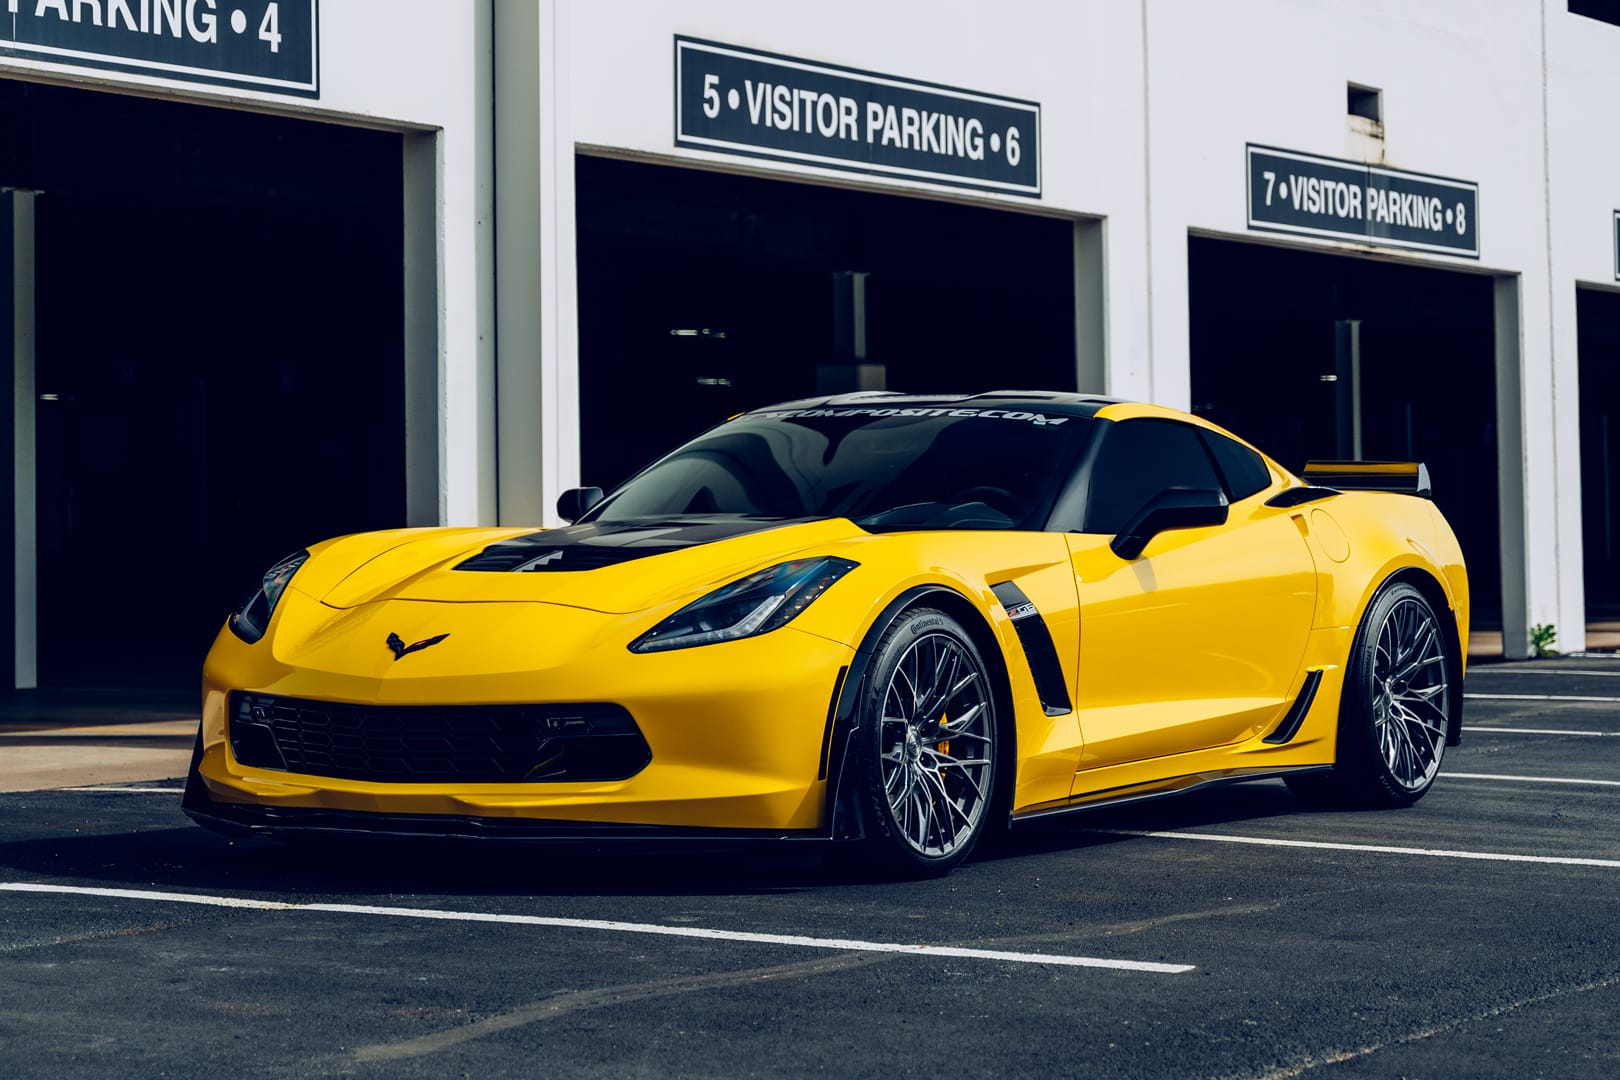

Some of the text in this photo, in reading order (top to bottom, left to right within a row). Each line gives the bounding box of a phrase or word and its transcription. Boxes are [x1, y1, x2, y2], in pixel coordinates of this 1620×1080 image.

[8, 0, 282, 53] KING 4
[702, 73, 1021, 167] 5 VISITOR PARKING 6
[1263, 171, 1466, 236] 7 VISITOR PARKING 8
